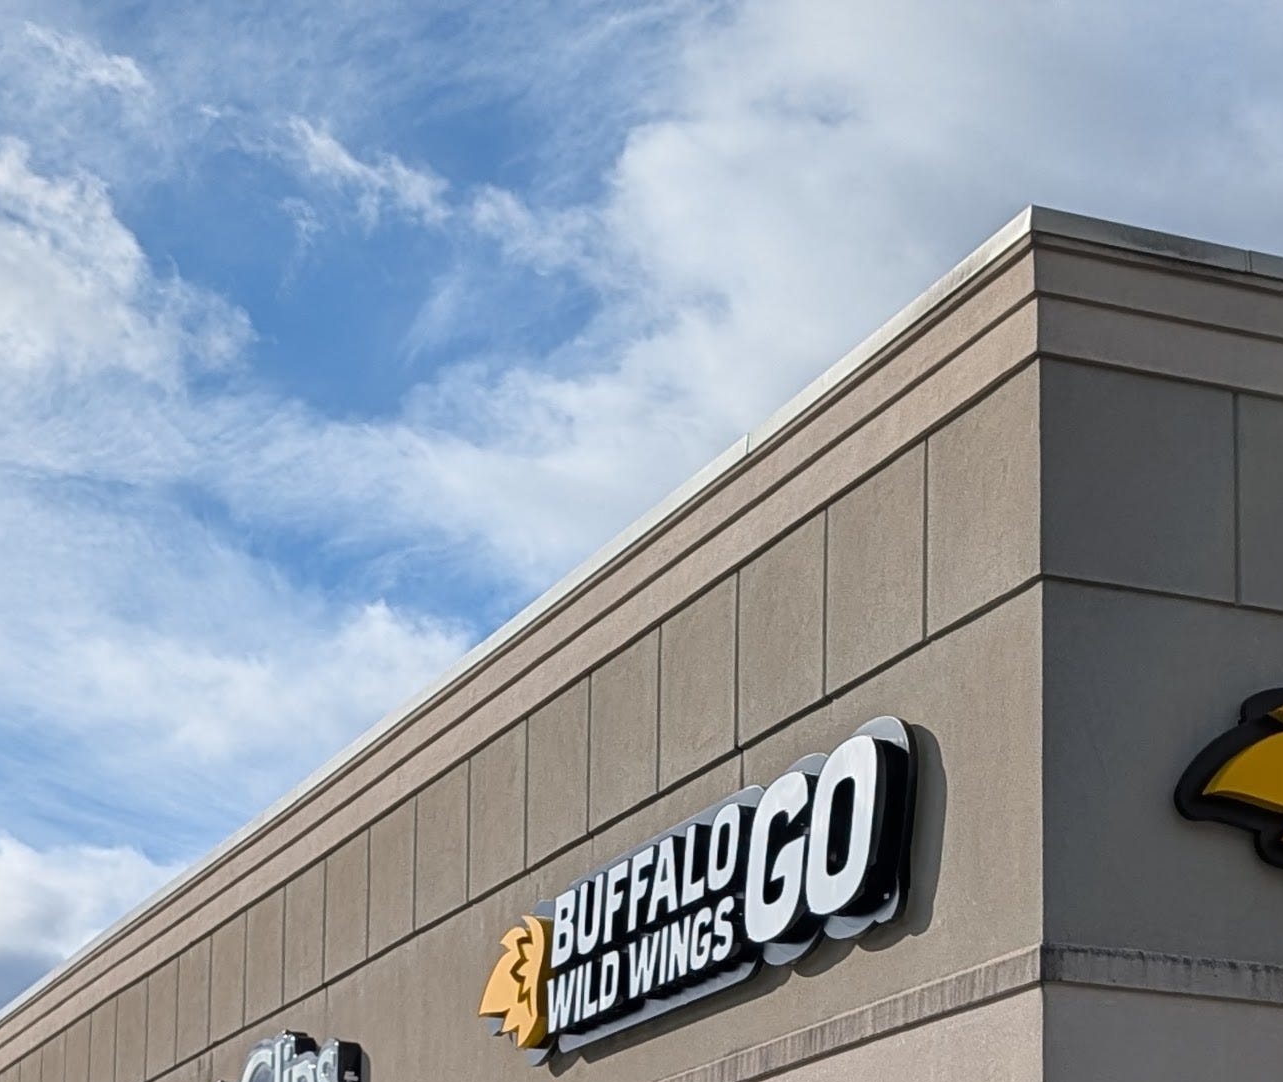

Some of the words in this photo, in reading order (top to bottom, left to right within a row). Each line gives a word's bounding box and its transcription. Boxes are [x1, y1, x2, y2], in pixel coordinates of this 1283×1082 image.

[551, 802, 741, 968] BUFFALO
[744, 735, 878, 943] GO
[547, 949, 620, 1034] WILD
[629, 896, 733, 998] WINGS
